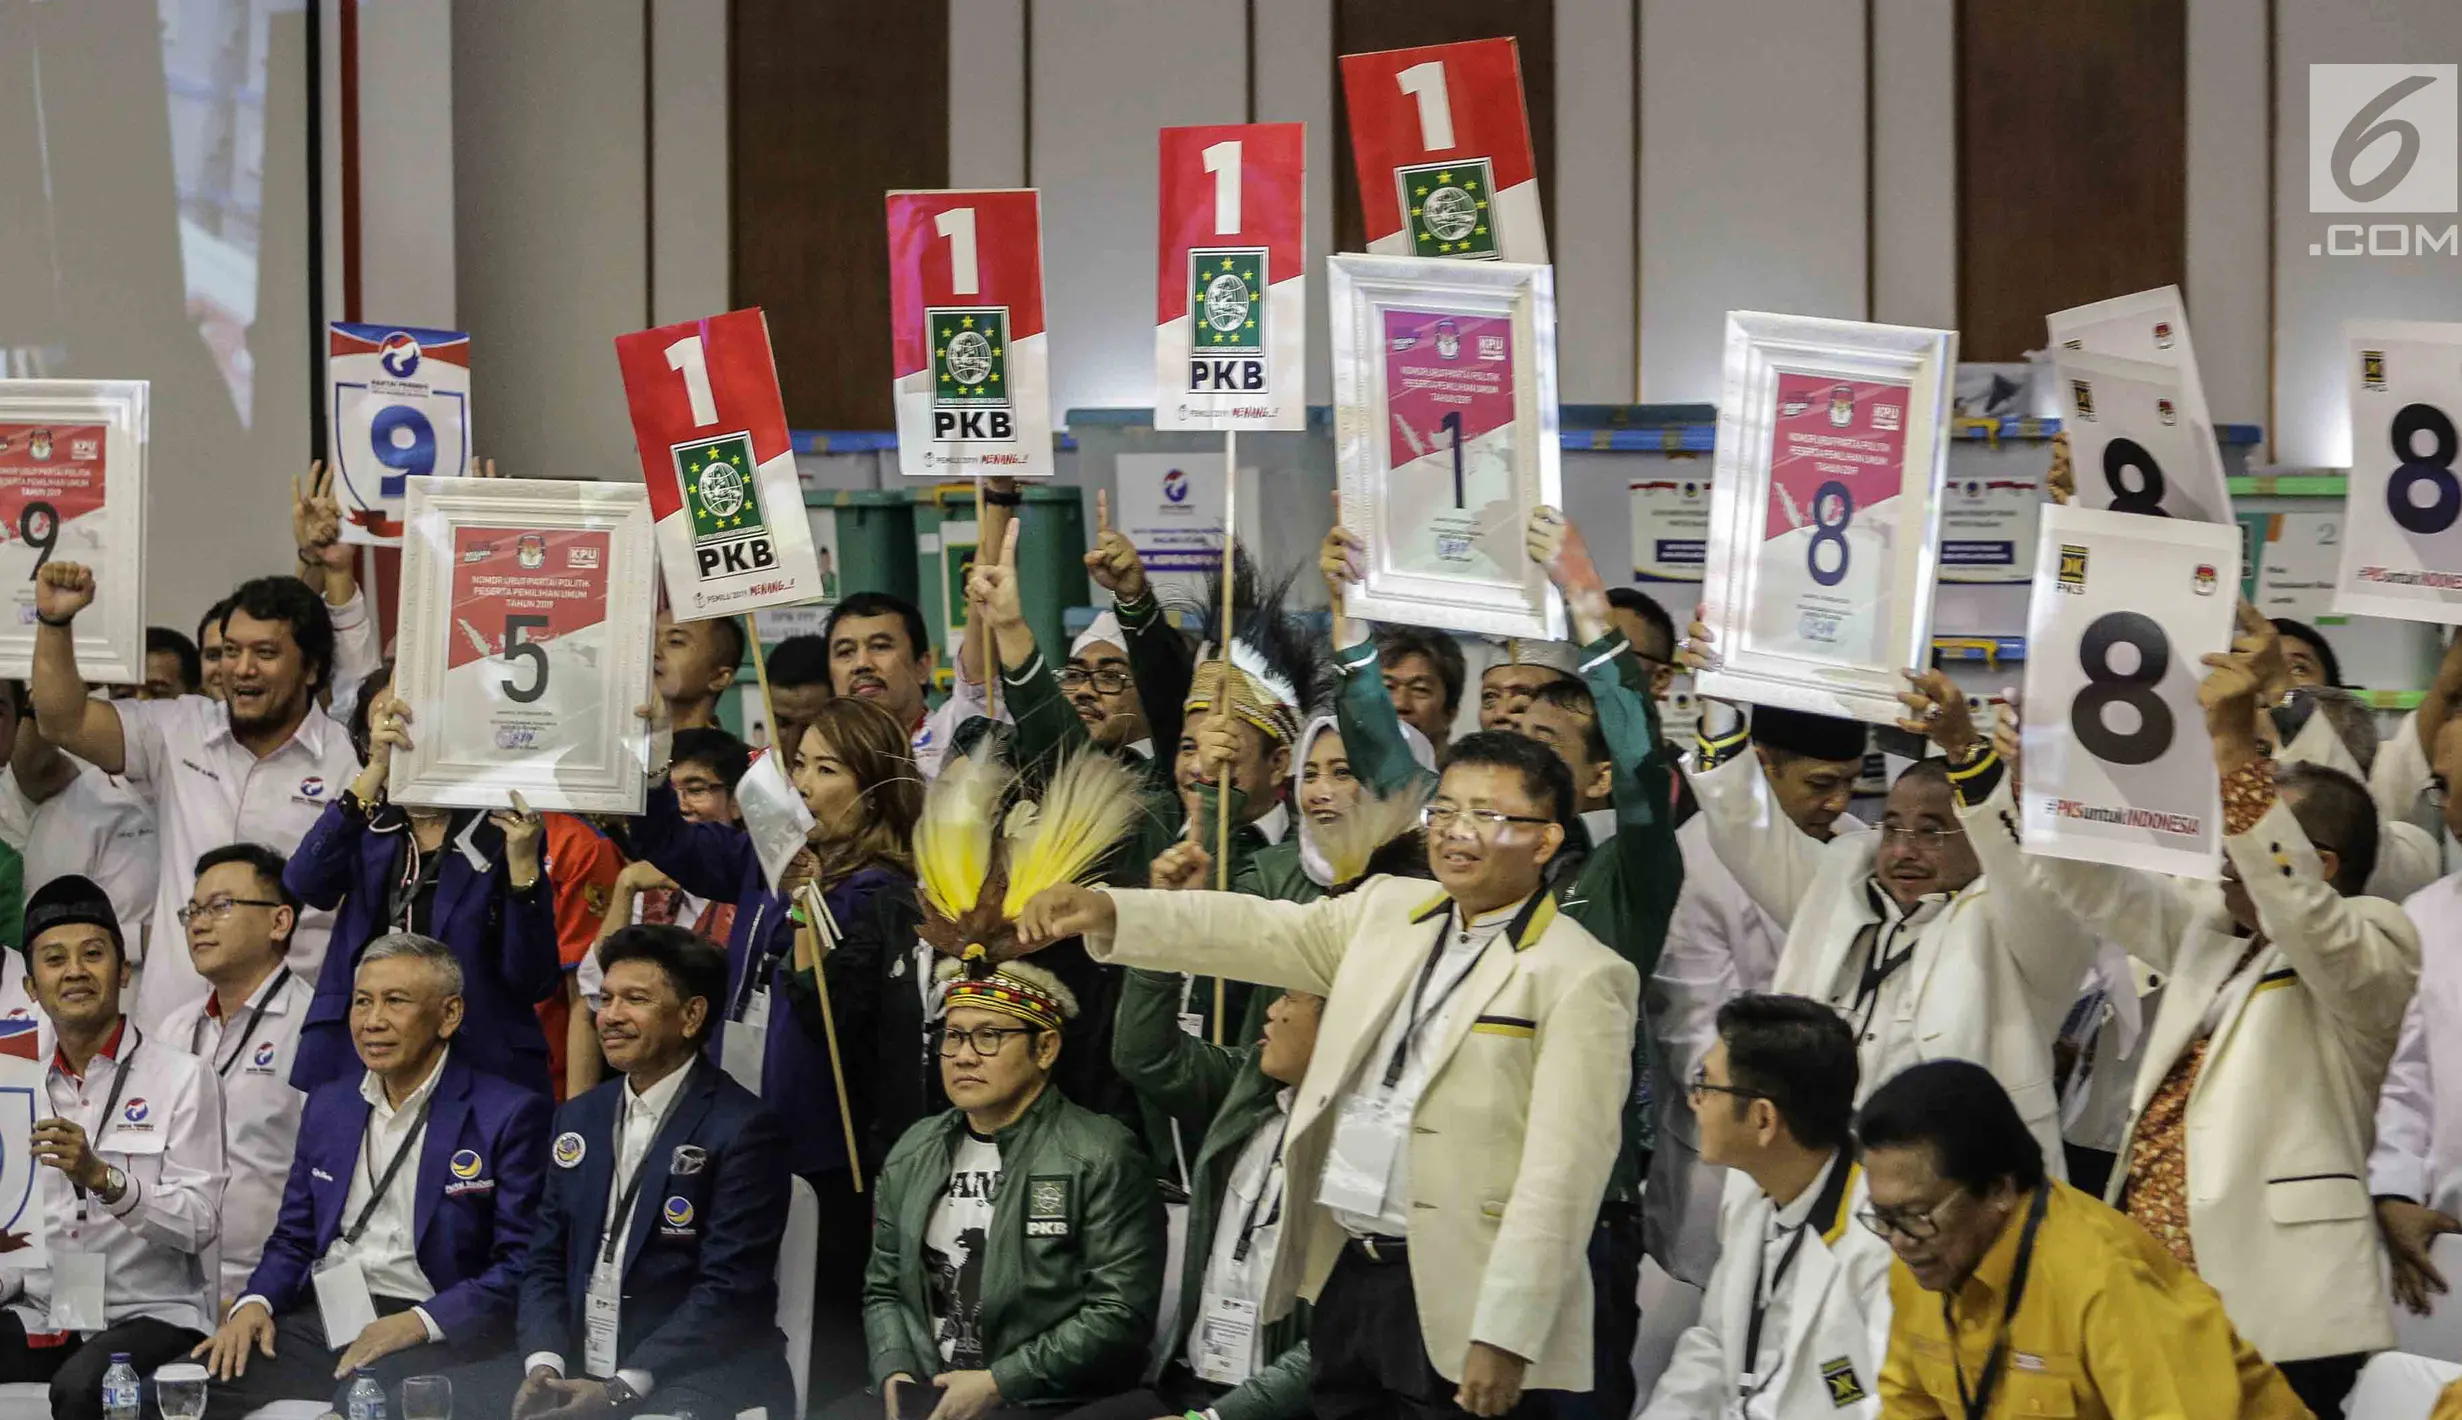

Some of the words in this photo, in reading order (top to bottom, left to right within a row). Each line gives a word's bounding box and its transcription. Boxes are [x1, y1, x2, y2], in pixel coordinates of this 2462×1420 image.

[1396, 60, 1456, 151] 1
[1202, 140, 1242, 235] 1
[934, 207, 980, 295] 1
[664, 335, 719, 428] 1
[1191, 360, 1265, 390] PKB
[371, 405, 436, 498] 9
[934, 411, 1013, 439] PKB
[1441, 411, 1465, 509] 1
[2387, 403, 2462, 534] 8
[2103, 438, 2173, 517] 8
[20, 501, 60, 581] 9
[571, 549, 597, 560] KPU
[697, 539, 774, 577] PKB
[1807, 481, 1852, 586] 8
[2316, 523, 2338, 545] 2
[502, 614, 549, 703] 5
[2071, 610, 2175, 765] 8
[1026, 1221, 1068, 1236] PKB
